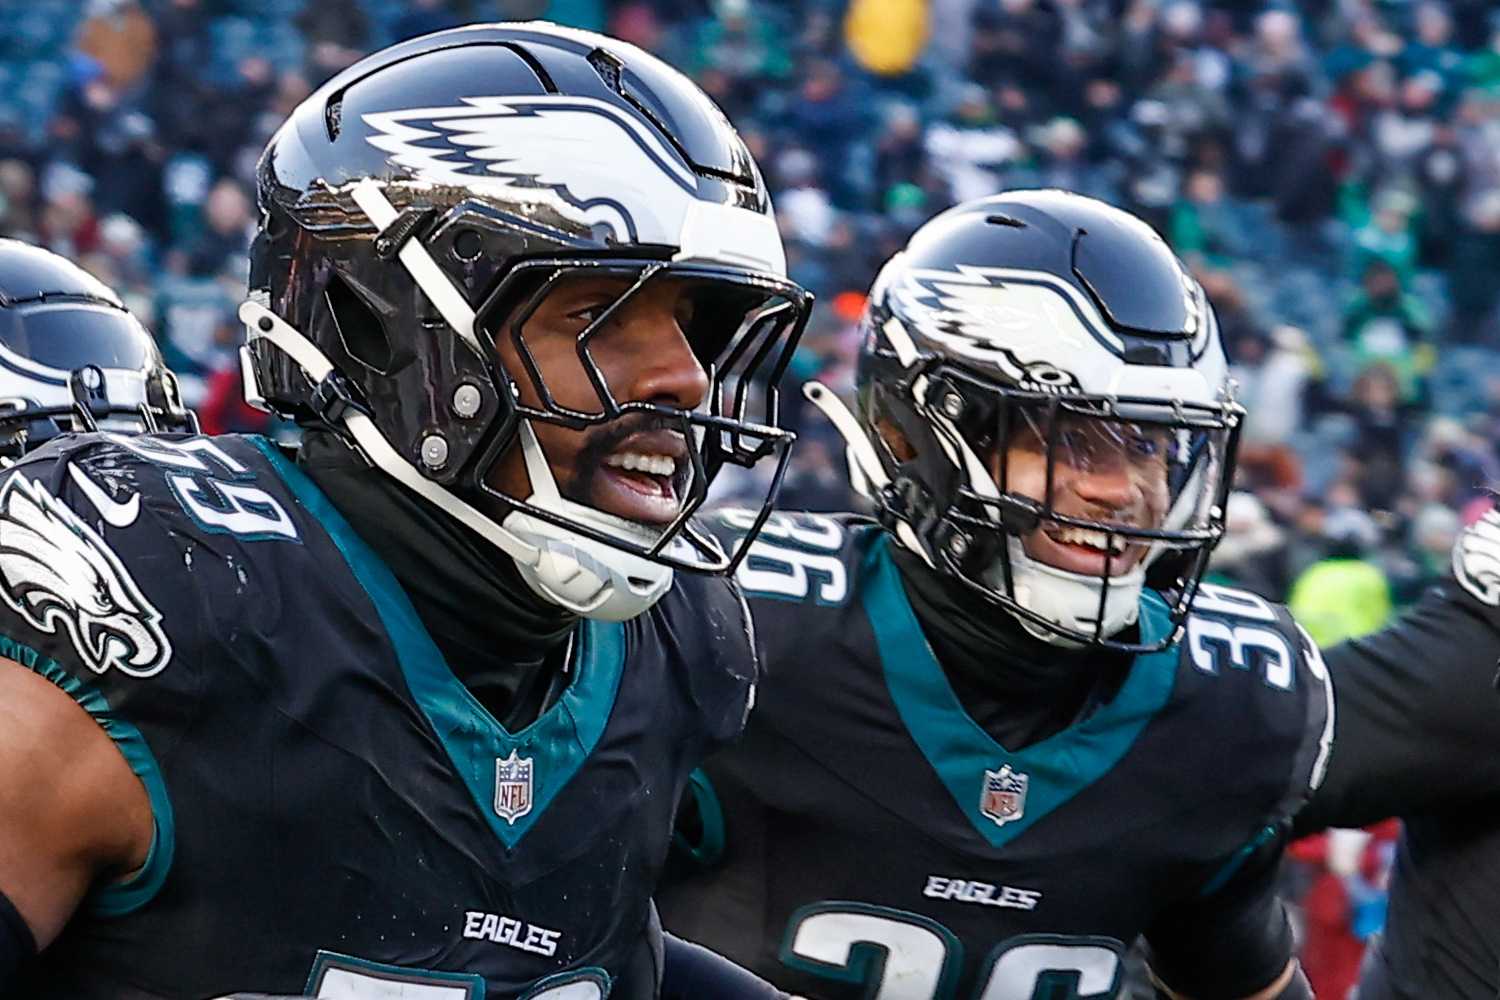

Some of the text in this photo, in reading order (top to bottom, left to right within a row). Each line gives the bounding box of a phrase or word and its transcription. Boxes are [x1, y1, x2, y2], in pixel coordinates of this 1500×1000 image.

[102, 432, 301, 543] 59
[718, 506, 849, 604] 36
[500, 784, 526, 811] NFL
[923, 875, 1042, 911] EAGLES
[463, 911, 562, 957] EAGLES
